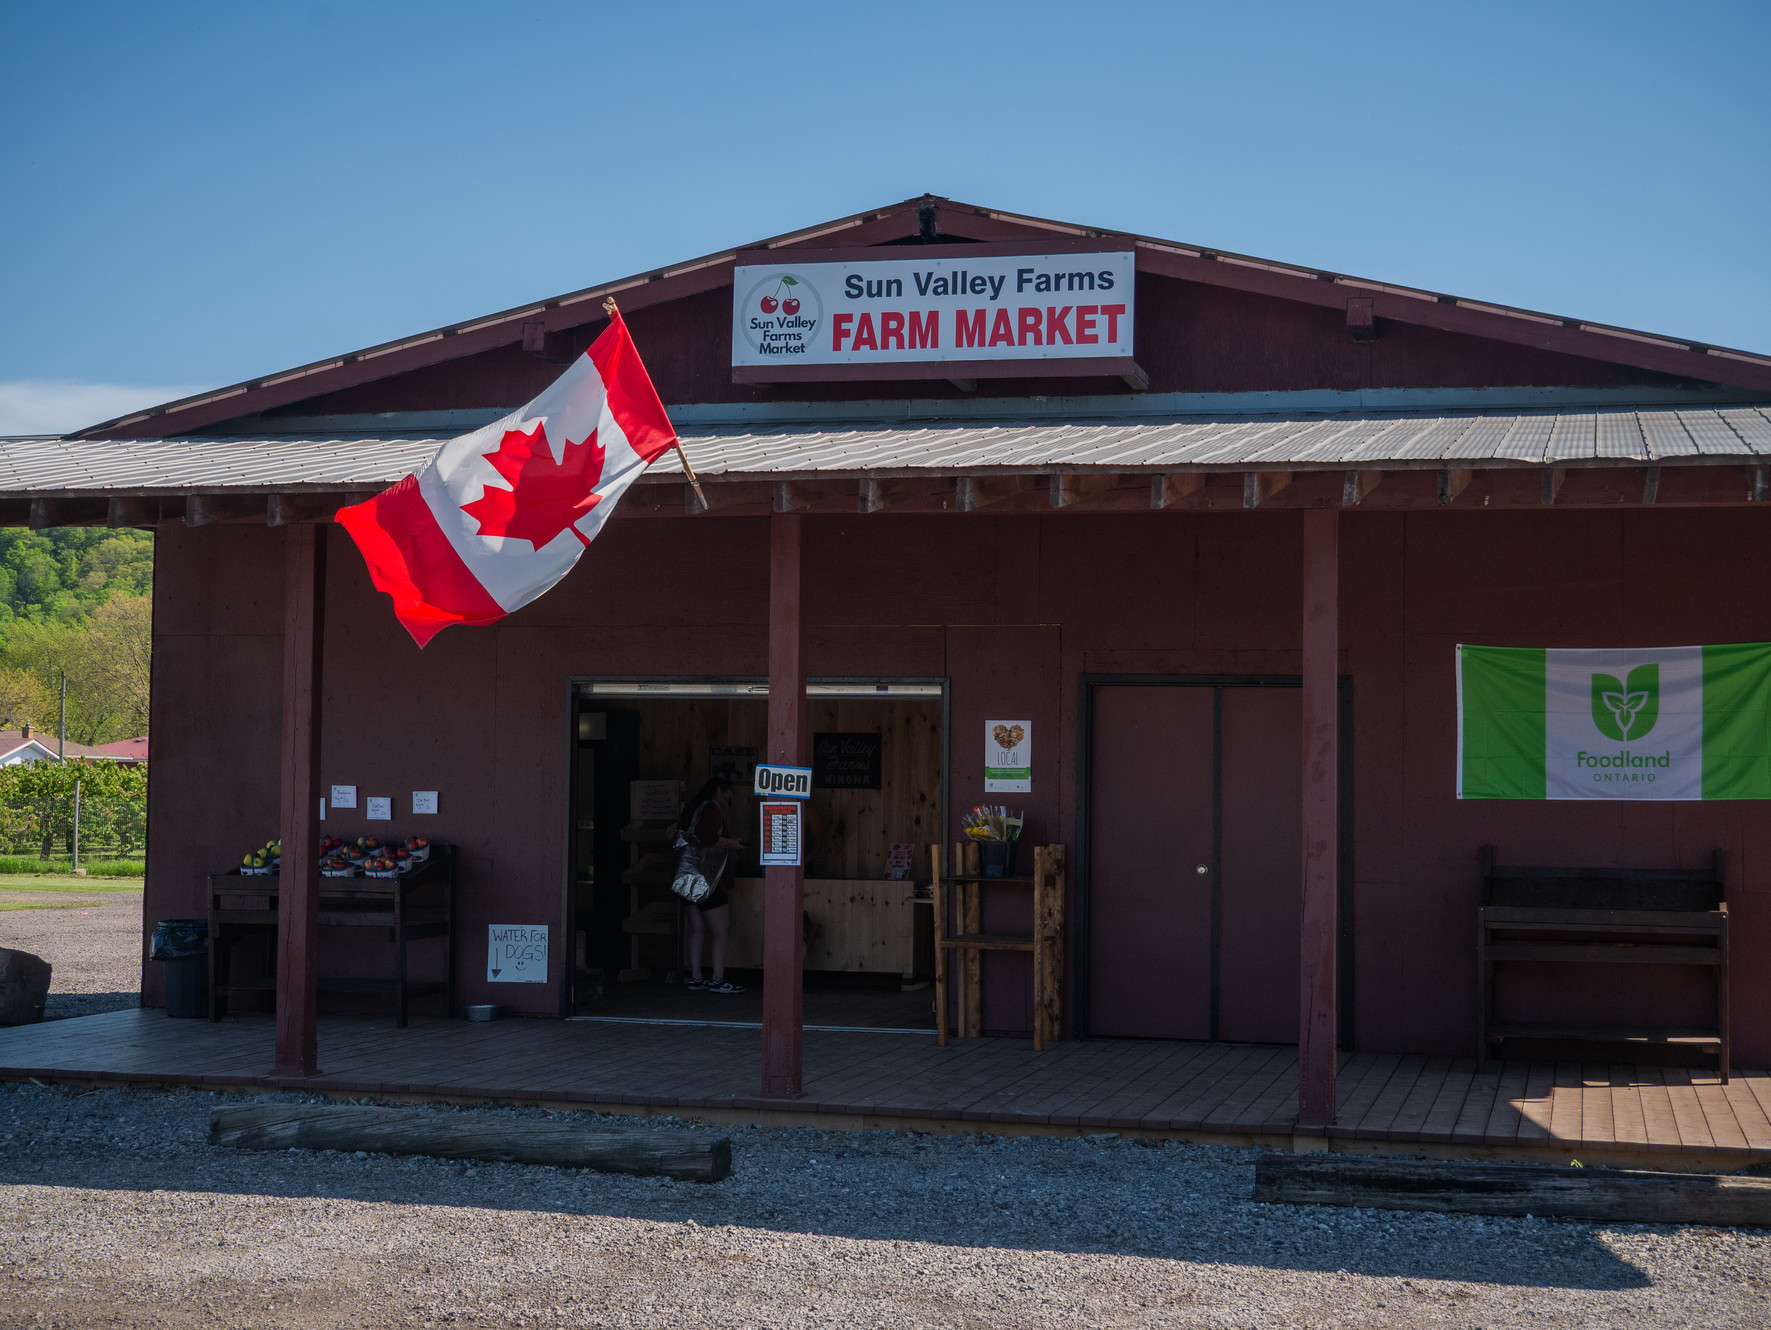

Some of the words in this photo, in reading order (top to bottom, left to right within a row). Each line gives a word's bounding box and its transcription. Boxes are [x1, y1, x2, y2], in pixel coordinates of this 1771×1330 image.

[844, 274, 902, 299] Sun
[913, 270, 1006, 301] Valley
[1017, 268, 1115, 293] Farms
[750, 317, 774, 330] Sun
[776, 315, 816, 331] Valley
[832, 310, 939, 352] FARM
[955, 304, 1126, 348] MARKET
[763, 330, 802, 342] Farms
[759, 341, 806, 355] Market
[818, 739, 840, 754] Sun
[840, 739, 876, 758] Valley
[825, 755, 872, 770] Farms
[997, 751, 1019, 766] LOCAL
[1577, 750, 1670, 768] Foodland
[758, 768, 808, 792] Open
[824, 774, 870, 785] WINONA
[1593, 773, 1656, 782] ONTARIO
[492, 928, 528, 943] WATER
[530, 929, 547, 943] FOR
